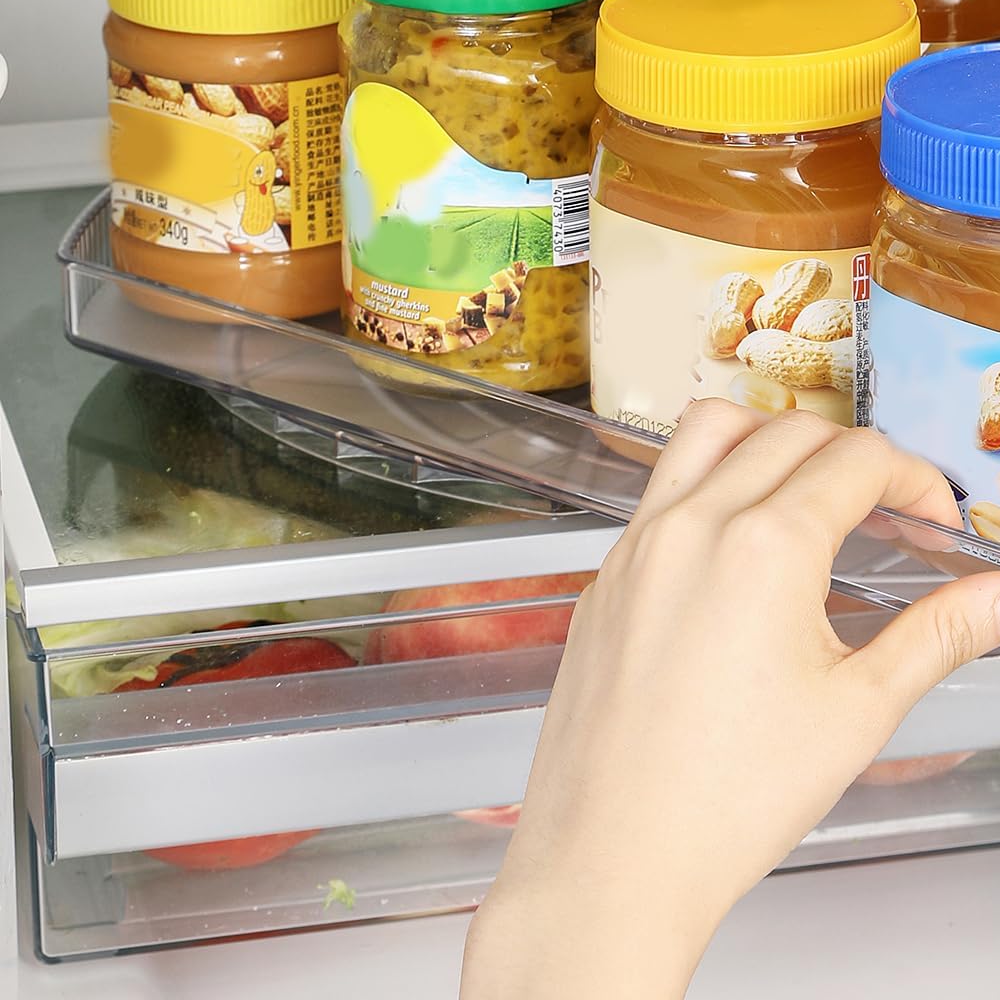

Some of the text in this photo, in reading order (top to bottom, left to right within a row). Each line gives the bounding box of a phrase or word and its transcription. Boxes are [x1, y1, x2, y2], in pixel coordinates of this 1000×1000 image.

[159, 217, 188, 246] 340g
[371, 280, 409, 299] mustard
[389, 307, 420, 320] mustard
[396, 299, 430, 312] gherkins
